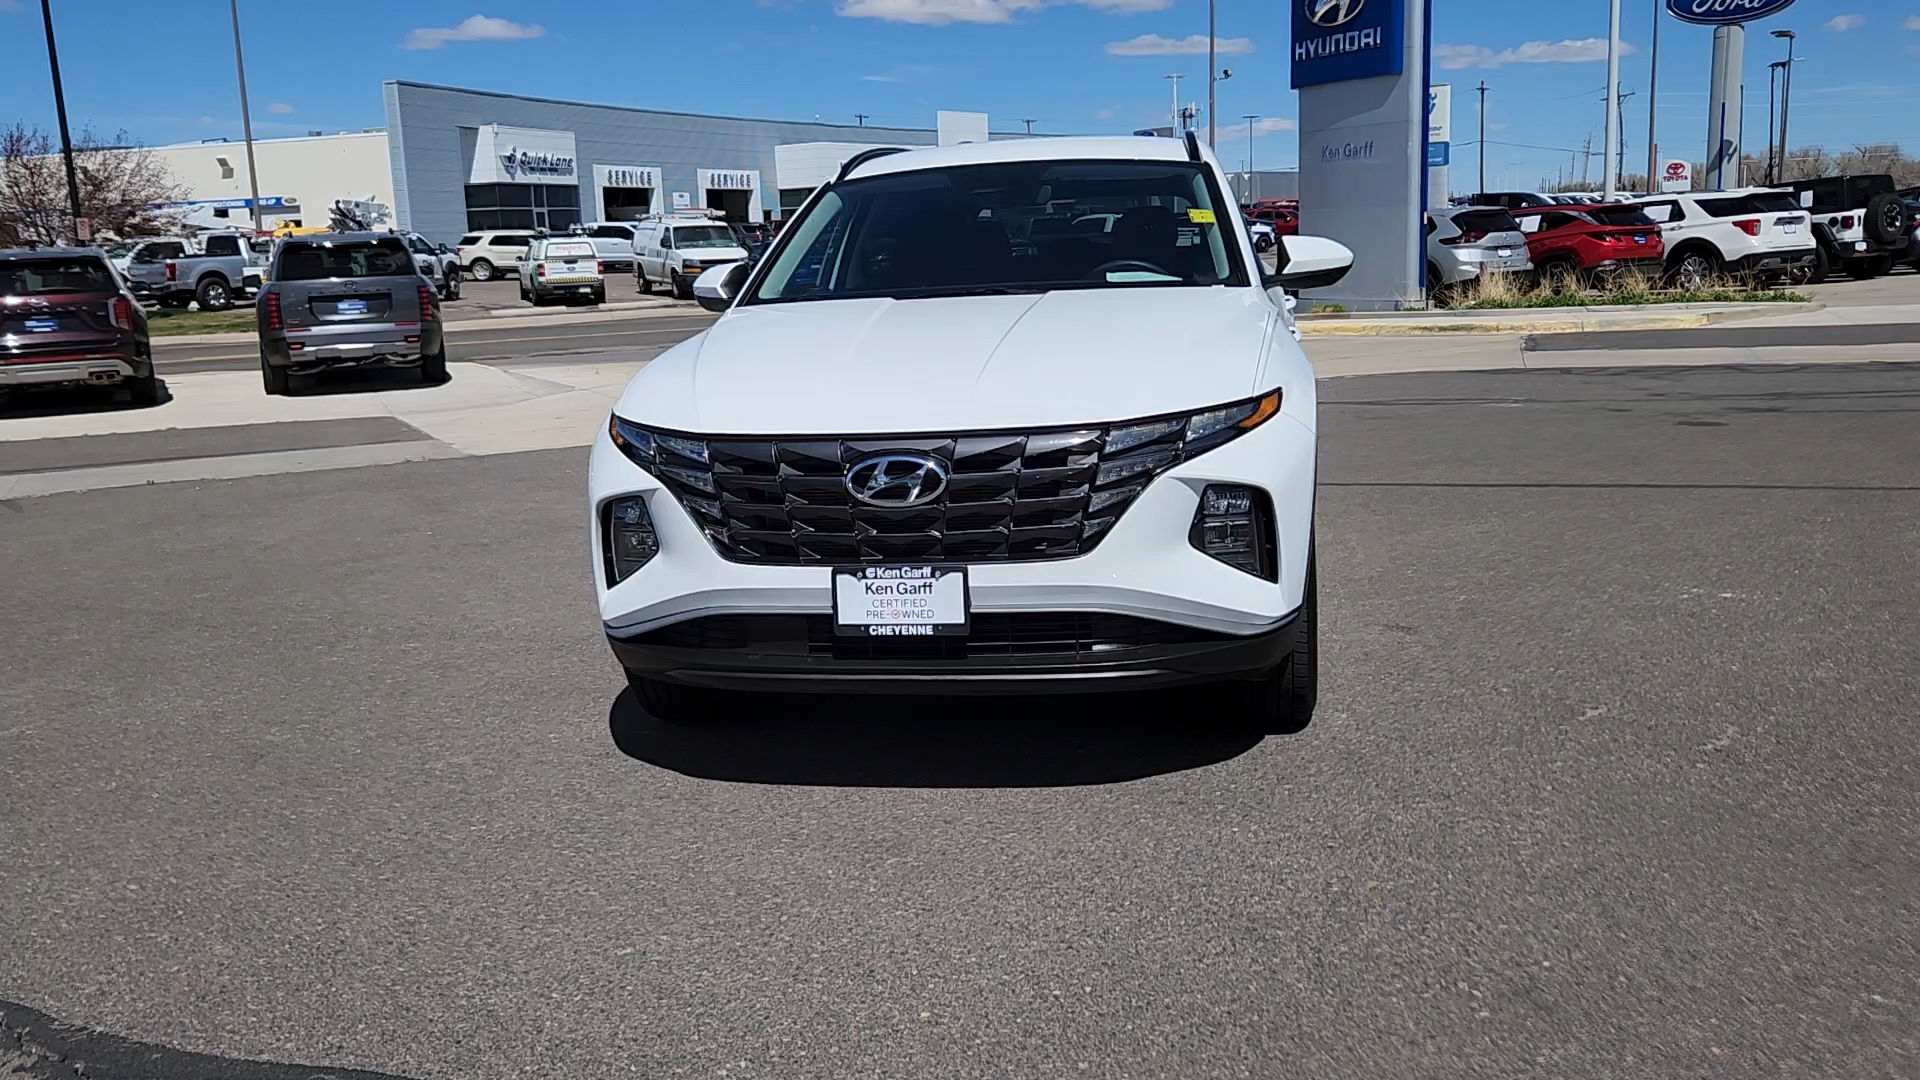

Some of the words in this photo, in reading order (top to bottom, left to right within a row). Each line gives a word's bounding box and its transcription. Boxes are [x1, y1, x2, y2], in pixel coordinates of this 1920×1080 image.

[1295, 26, 1381, 61] HYUNDAI
[1321, 145, 1340, 159] Ken
[1343, 140, 1374, 158] Garff
[518, 151, 549, 167] Quick
[550, 153, 573, 167] Lane
[607, 169, 652, 183] SERVICE
[710, 173, 751, 186] SERVICE
[876, 567, 900, 578] Ken
[901, 566, 932, 578] Garff
[865, 582, 894, 595] Ken
[896, 582, 933, 595] Garff
[872, 599, 928, 609] CERTIFIED
[866, 609, 935, 620] PRE-OWNED
[869, 625, 934, 636] CHEYENNE
